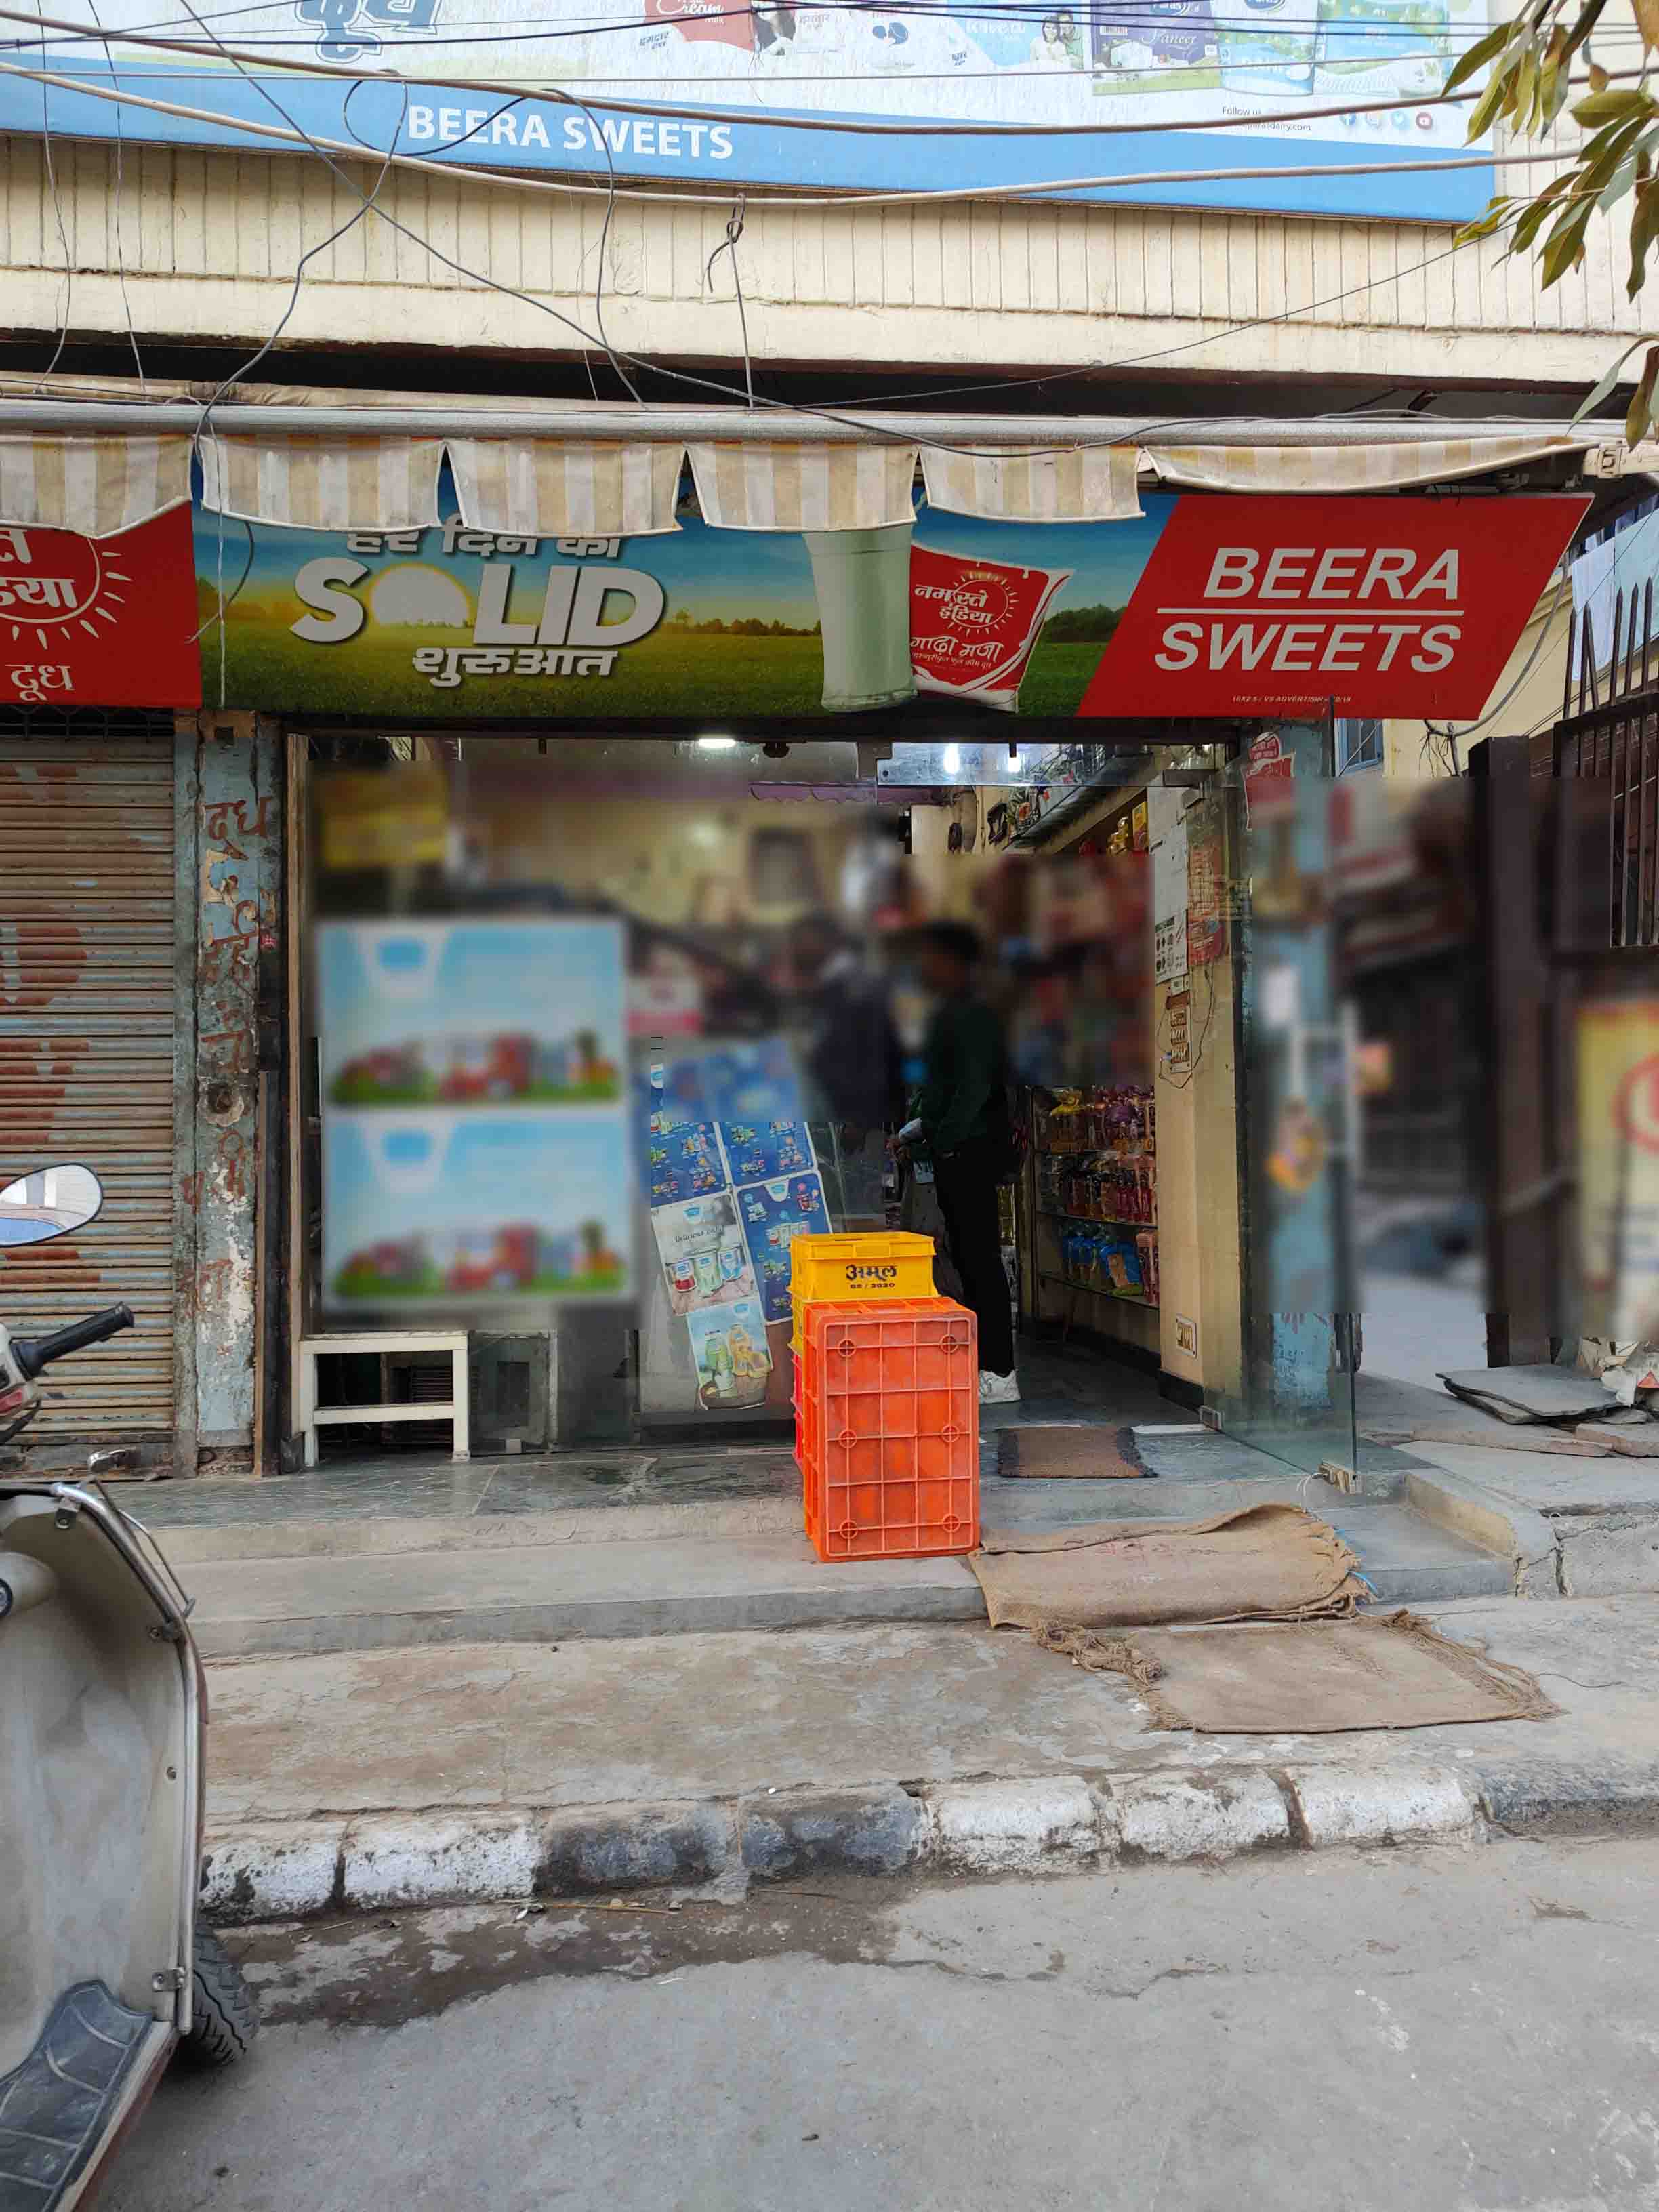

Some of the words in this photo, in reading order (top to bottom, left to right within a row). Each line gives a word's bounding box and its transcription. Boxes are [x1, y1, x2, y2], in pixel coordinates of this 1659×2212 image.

[408, 105, 551, 148] BEERA
[563, 115, 733, 159] SWEETS
[1204, 547, 1460, 600] BEERA
[914, 583, 988, 608] नमस्ते
[939, 602, 994, 624] इंडिया
[1154, 621, 1462, 673] SWEETS
[5, 664, 76, 701] दूध
[846, 1265, 898, 1282] अमूल
